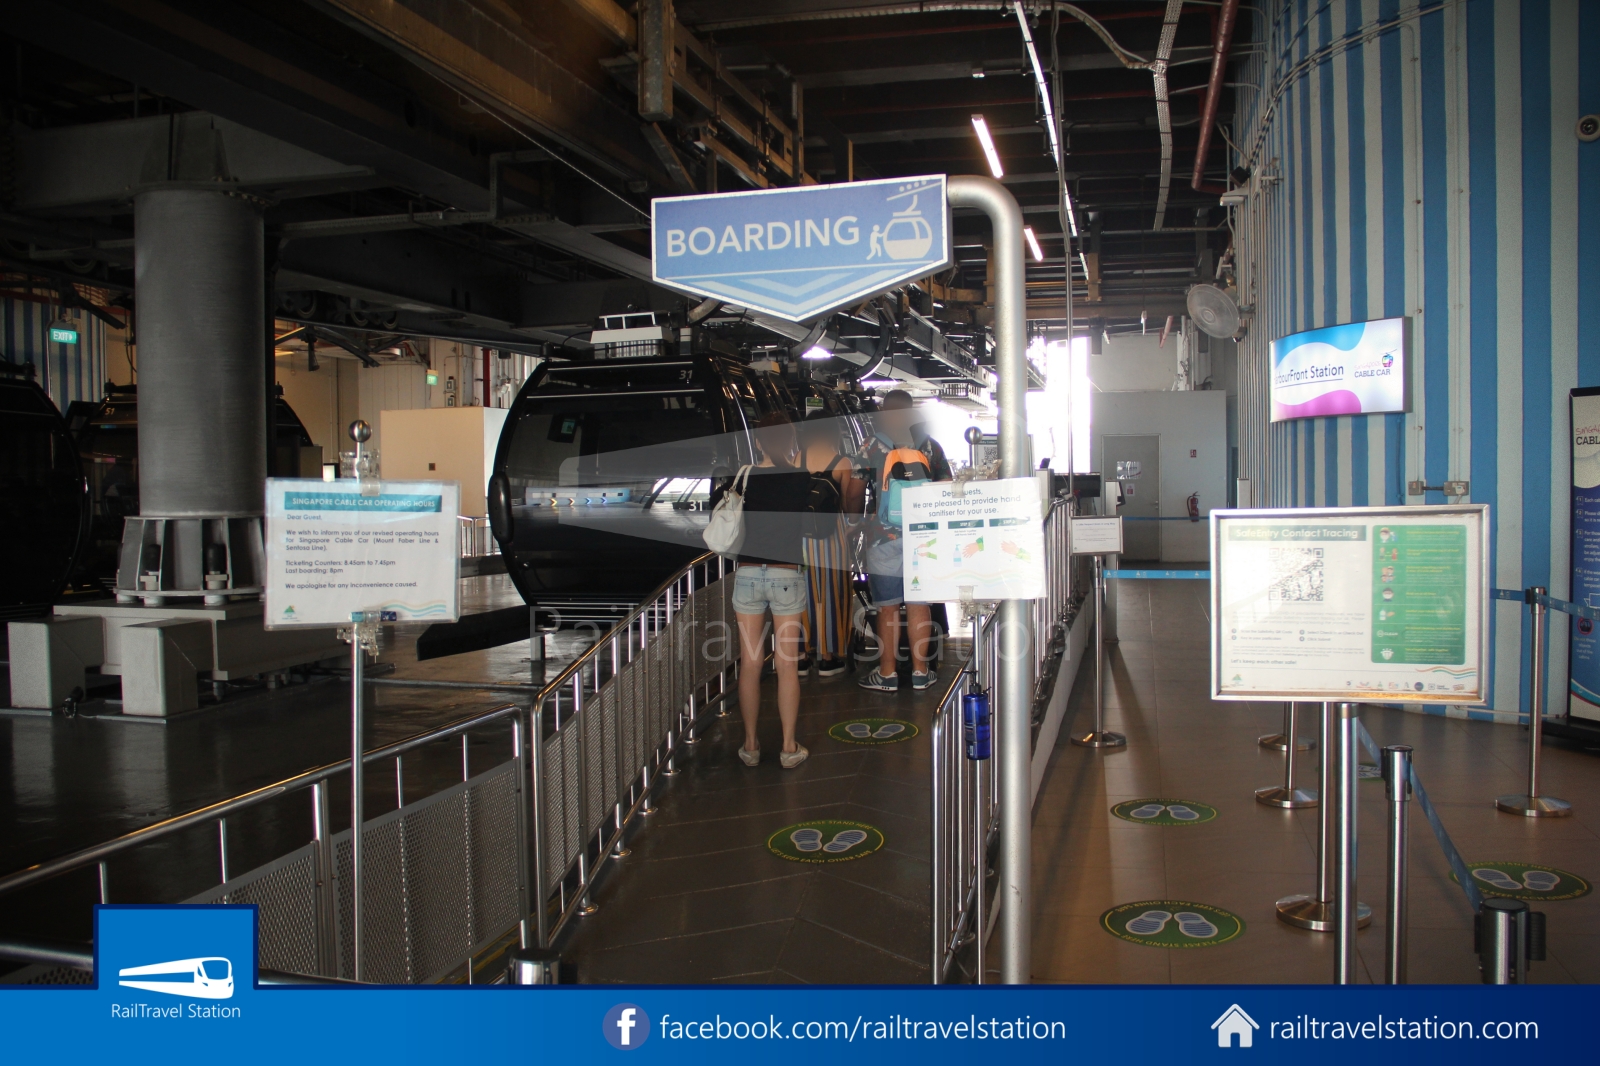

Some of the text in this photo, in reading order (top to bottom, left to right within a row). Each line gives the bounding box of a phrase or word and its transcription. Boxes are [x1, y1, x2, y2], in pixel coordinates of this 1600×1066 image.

[666, 216, 860, 257] BOARDING
[53, 331, 69, 341] EXIT
[679, 370, 693, 380] 31
[1310, 364, 1344, 379] Station
[1354, 368, 1391, 379] CABLE CAR
[292, 498, 332, 506] SINGAPORE
[334, 498, 356, 506] CABLE
[413, 500, 435, 508] HOURS
[689, 500, 703, 512] 31
[934, 500, 962, 509] pleased
[972, 498, 999, 507] provide
[1000, 495, 1021, 503] hand
[967, 509, 983, 517] your
[395, 530, 423, 538] operating
[1236, 528, 1358, 540] SafeEntry Contact Tracing
[299, 537, 330, 545] Singapore
[373, 537, 394, 545] (Mount
